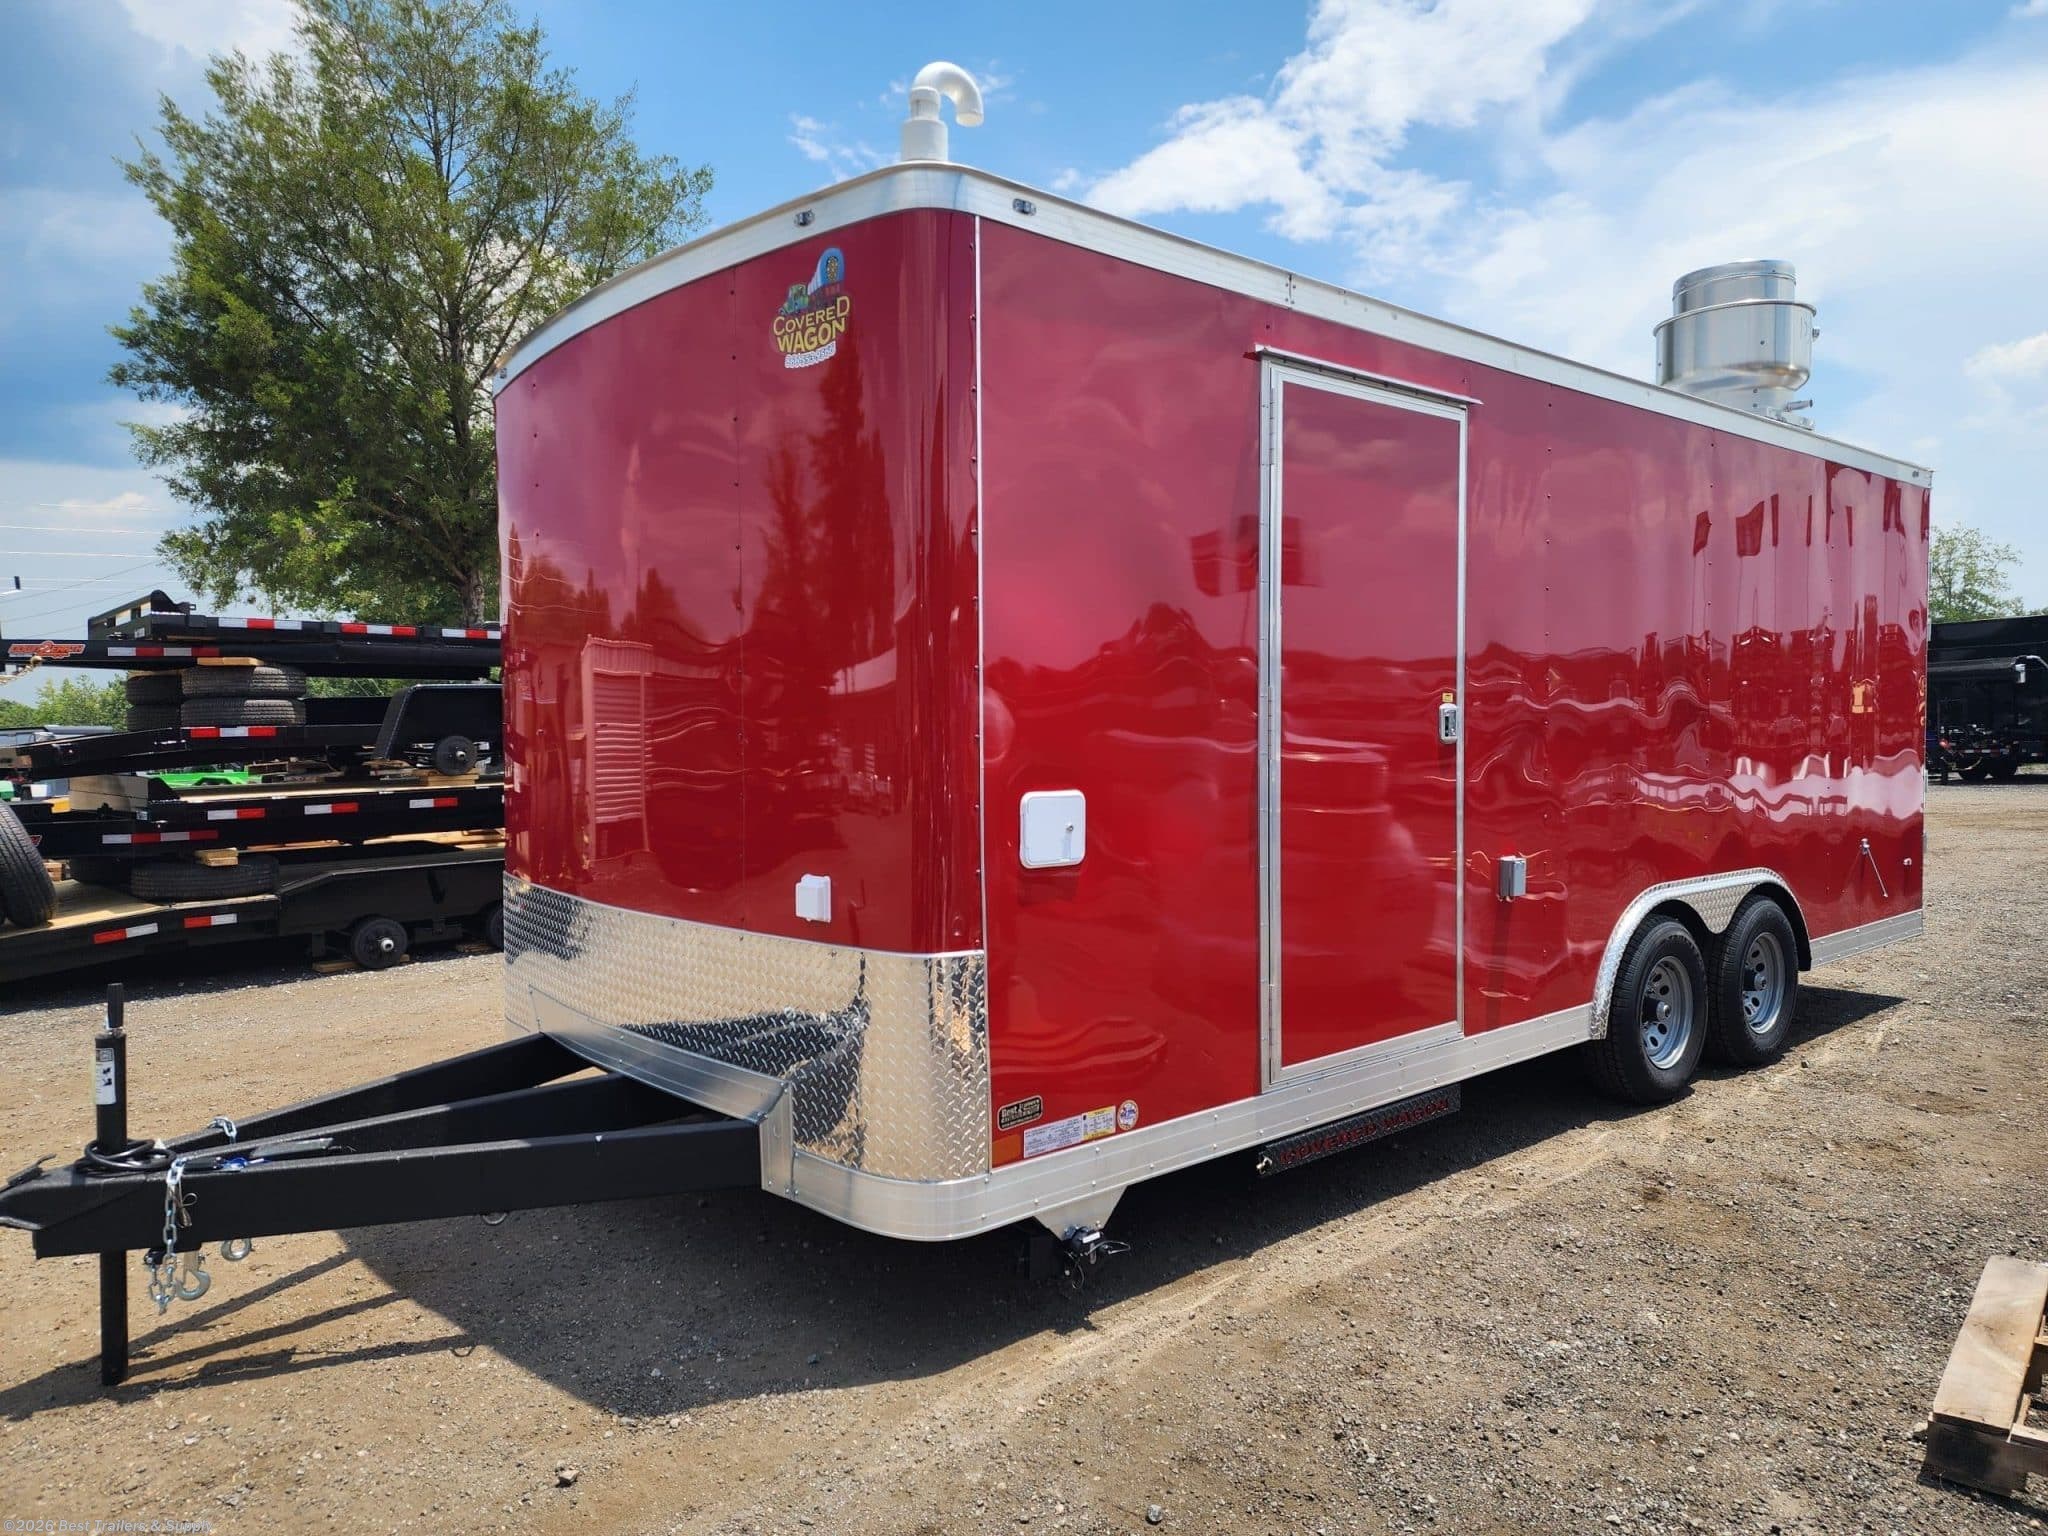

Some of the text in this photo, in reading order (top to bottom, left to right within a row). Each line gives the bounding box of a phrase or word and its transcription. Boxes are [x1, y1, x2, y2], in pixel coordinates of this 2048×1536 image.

[773, 295, 850, 336] COVERED
[777, 317, 846, 353] WAGON
[1280, 1100, 1449, 1164] COVERED WAGON
